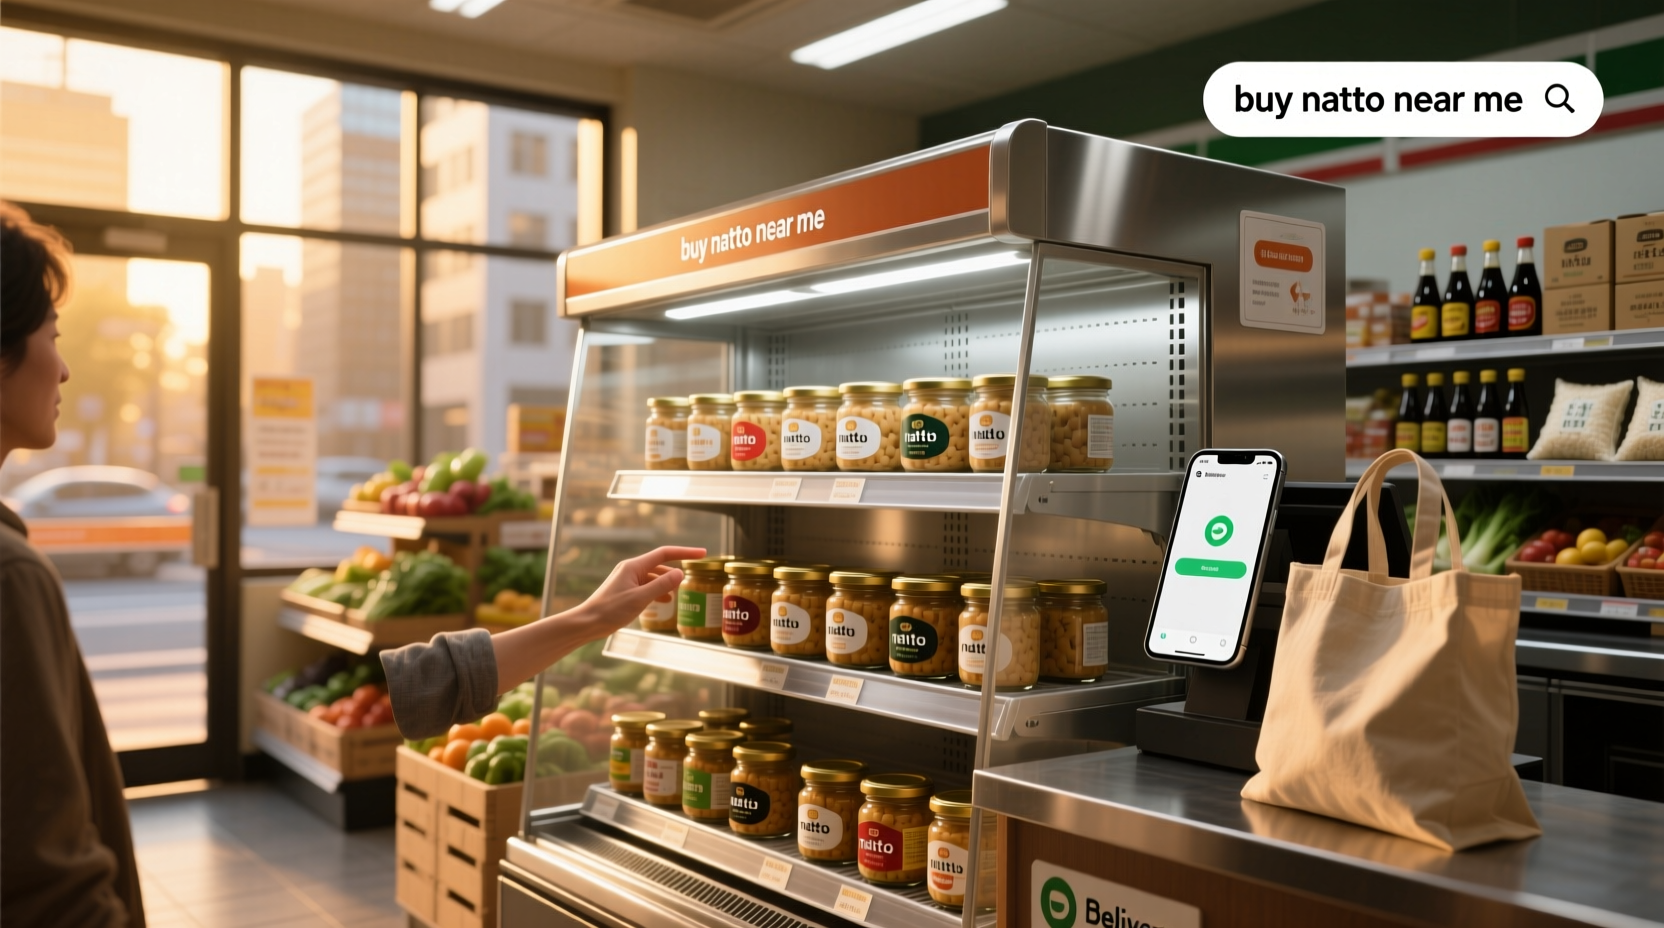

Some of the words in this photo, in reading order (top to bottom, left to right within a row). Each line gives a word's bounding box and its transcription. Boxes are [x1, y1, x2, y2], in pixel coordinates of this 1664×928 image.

[681, 236, 708, 264] buy
[711, 225, 752, 255] natto
[756, 216, 794, 243] near
[797, 209, 825, 235] me
